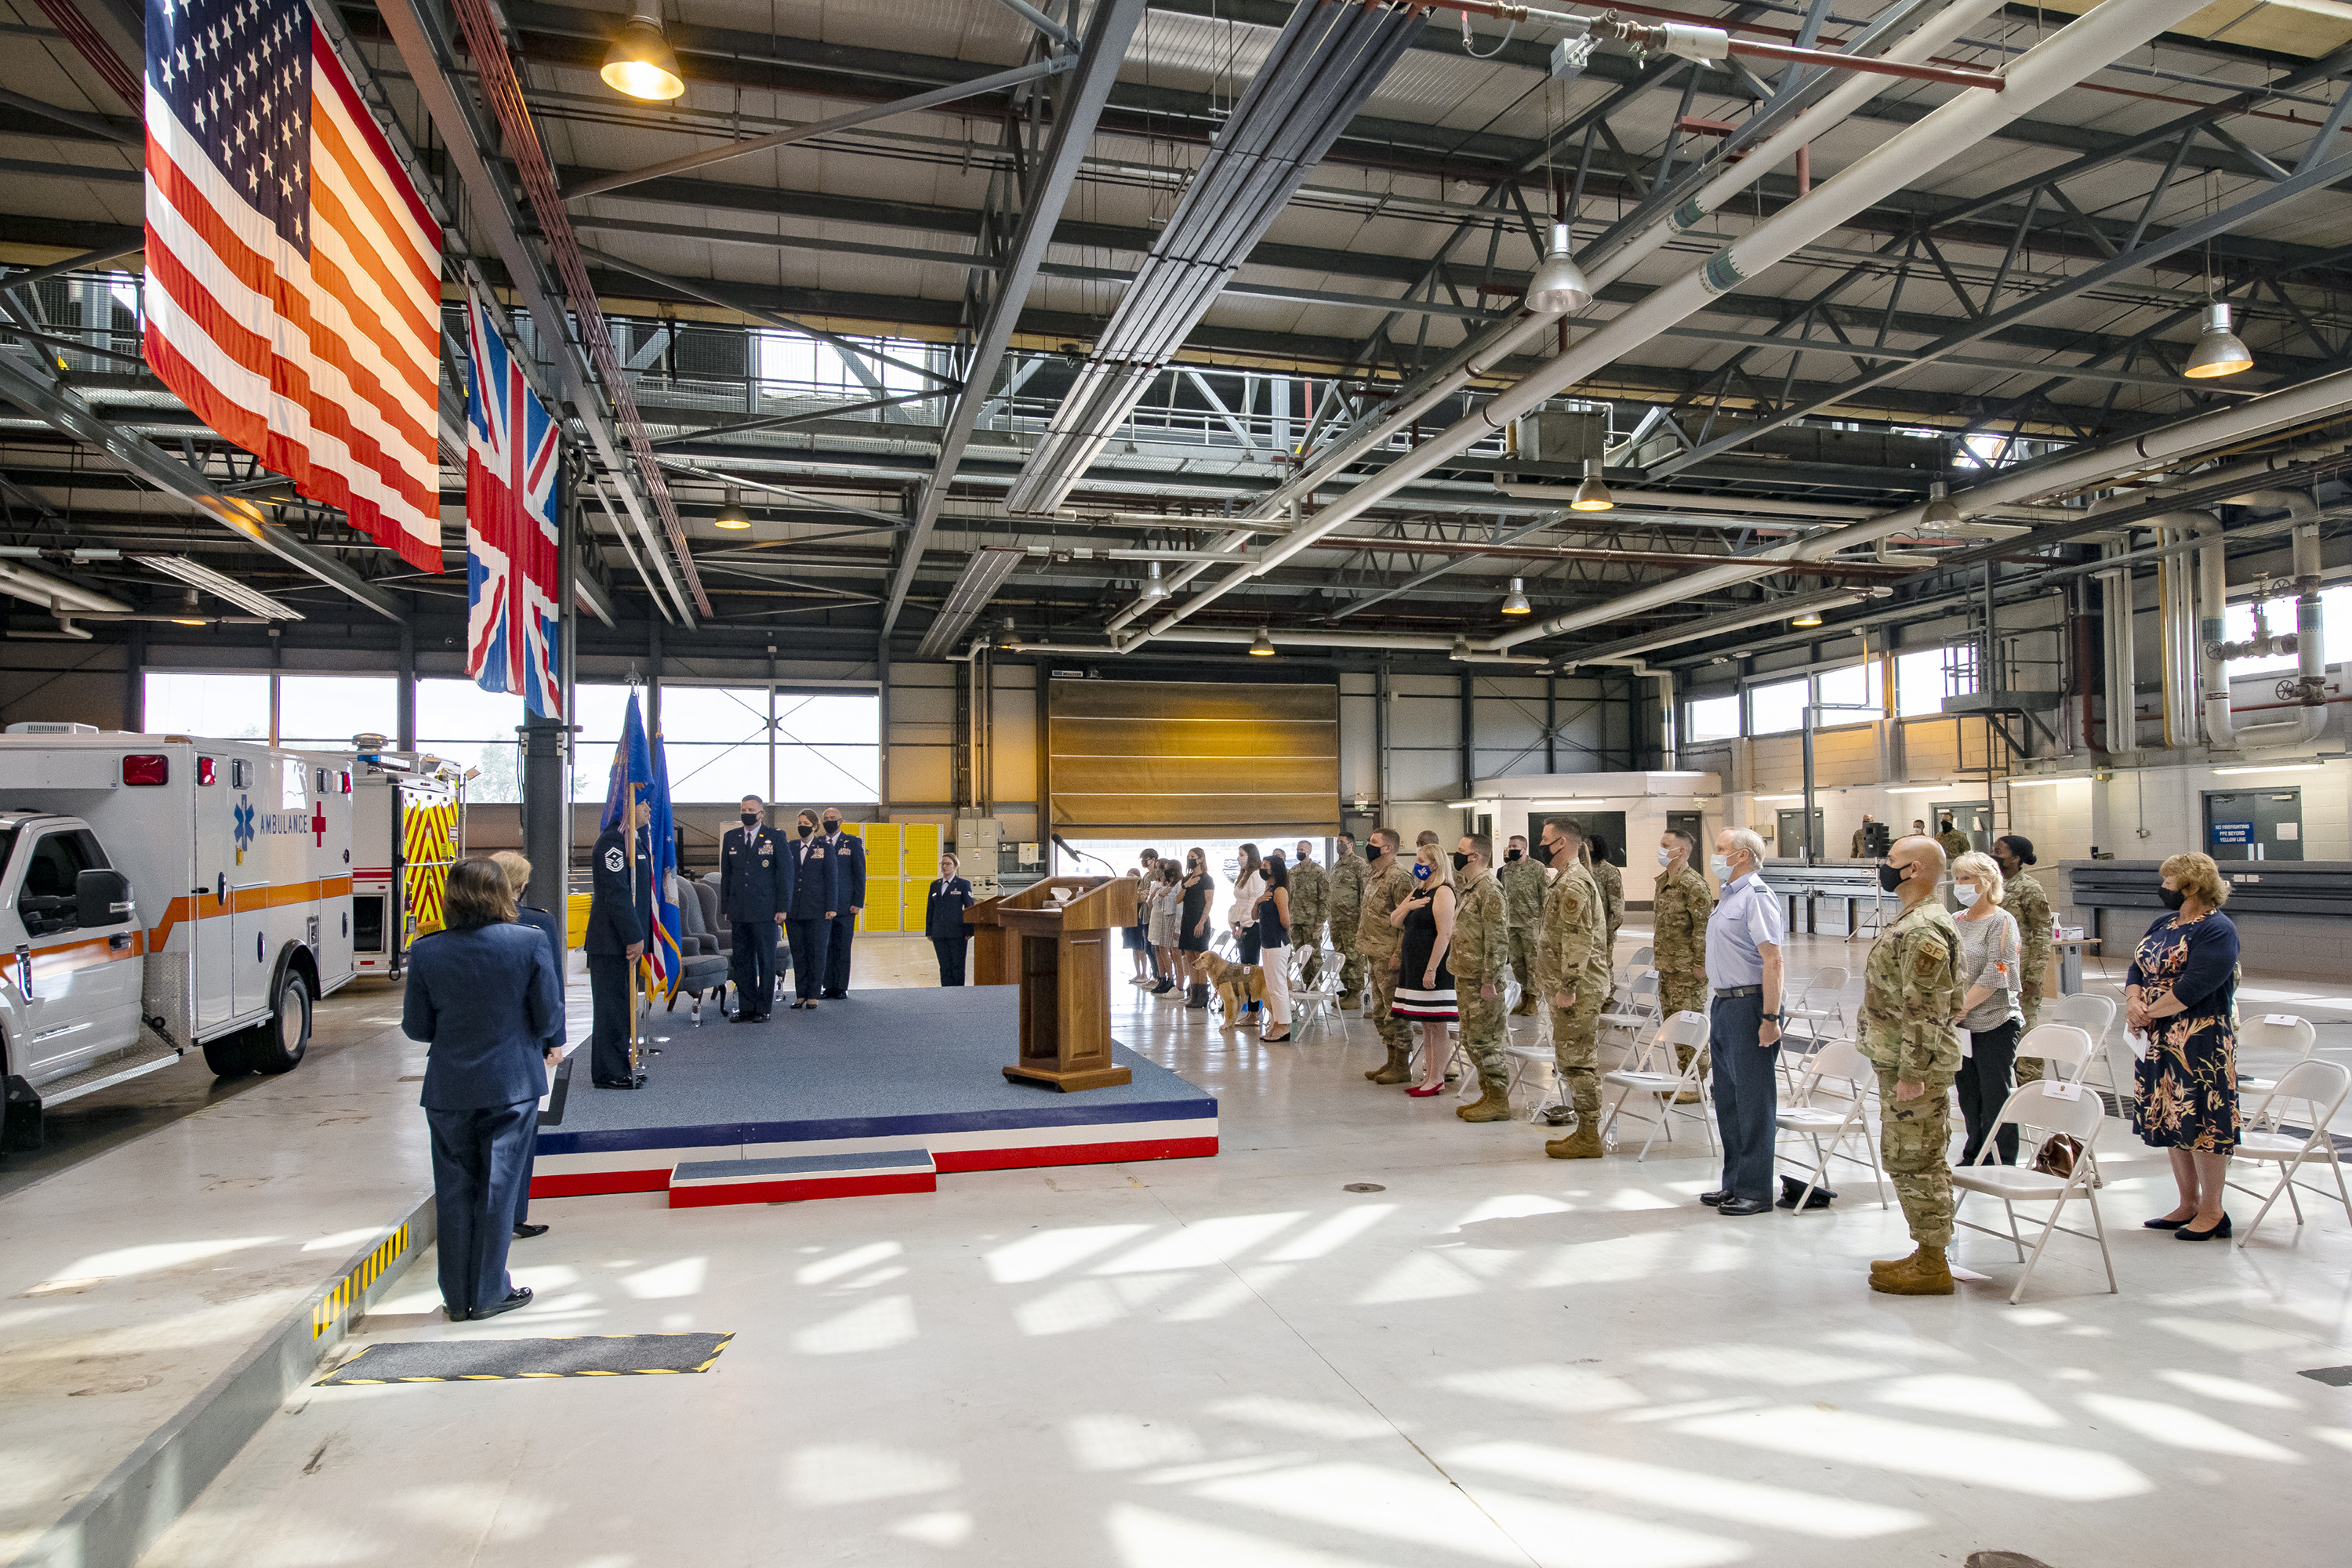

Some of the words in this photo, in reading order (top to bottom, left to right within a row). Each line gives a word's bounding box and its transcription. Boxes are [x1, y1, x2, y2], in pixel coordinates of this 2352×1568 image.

[260, 815, 307, 835] AMBULANCE
[1417, 866, 1428, 877] AF
[1923, 942, 1944, 955] SF
